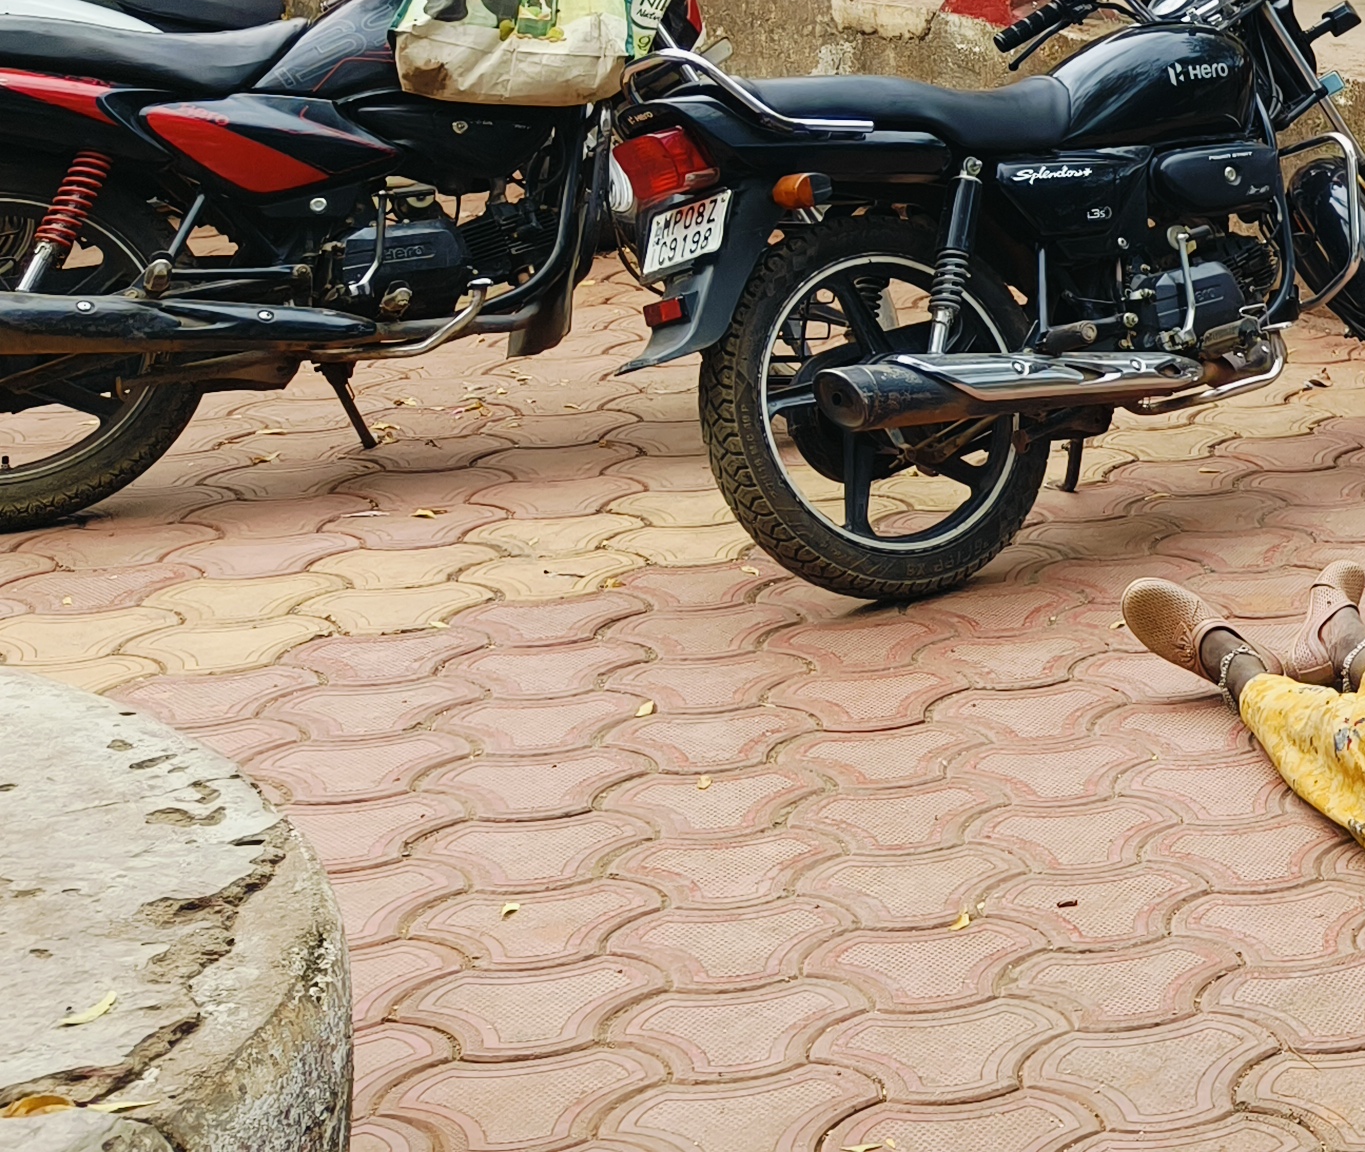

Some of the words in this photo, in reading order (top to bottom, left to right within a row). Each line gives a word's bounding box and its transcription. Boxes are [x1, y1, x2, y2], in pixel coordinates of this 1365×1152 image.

[1188, 62, 1229, 80] Hero
[662, 198, 718, 240] MP08Z
[658, 227, 713, 266] C9198
